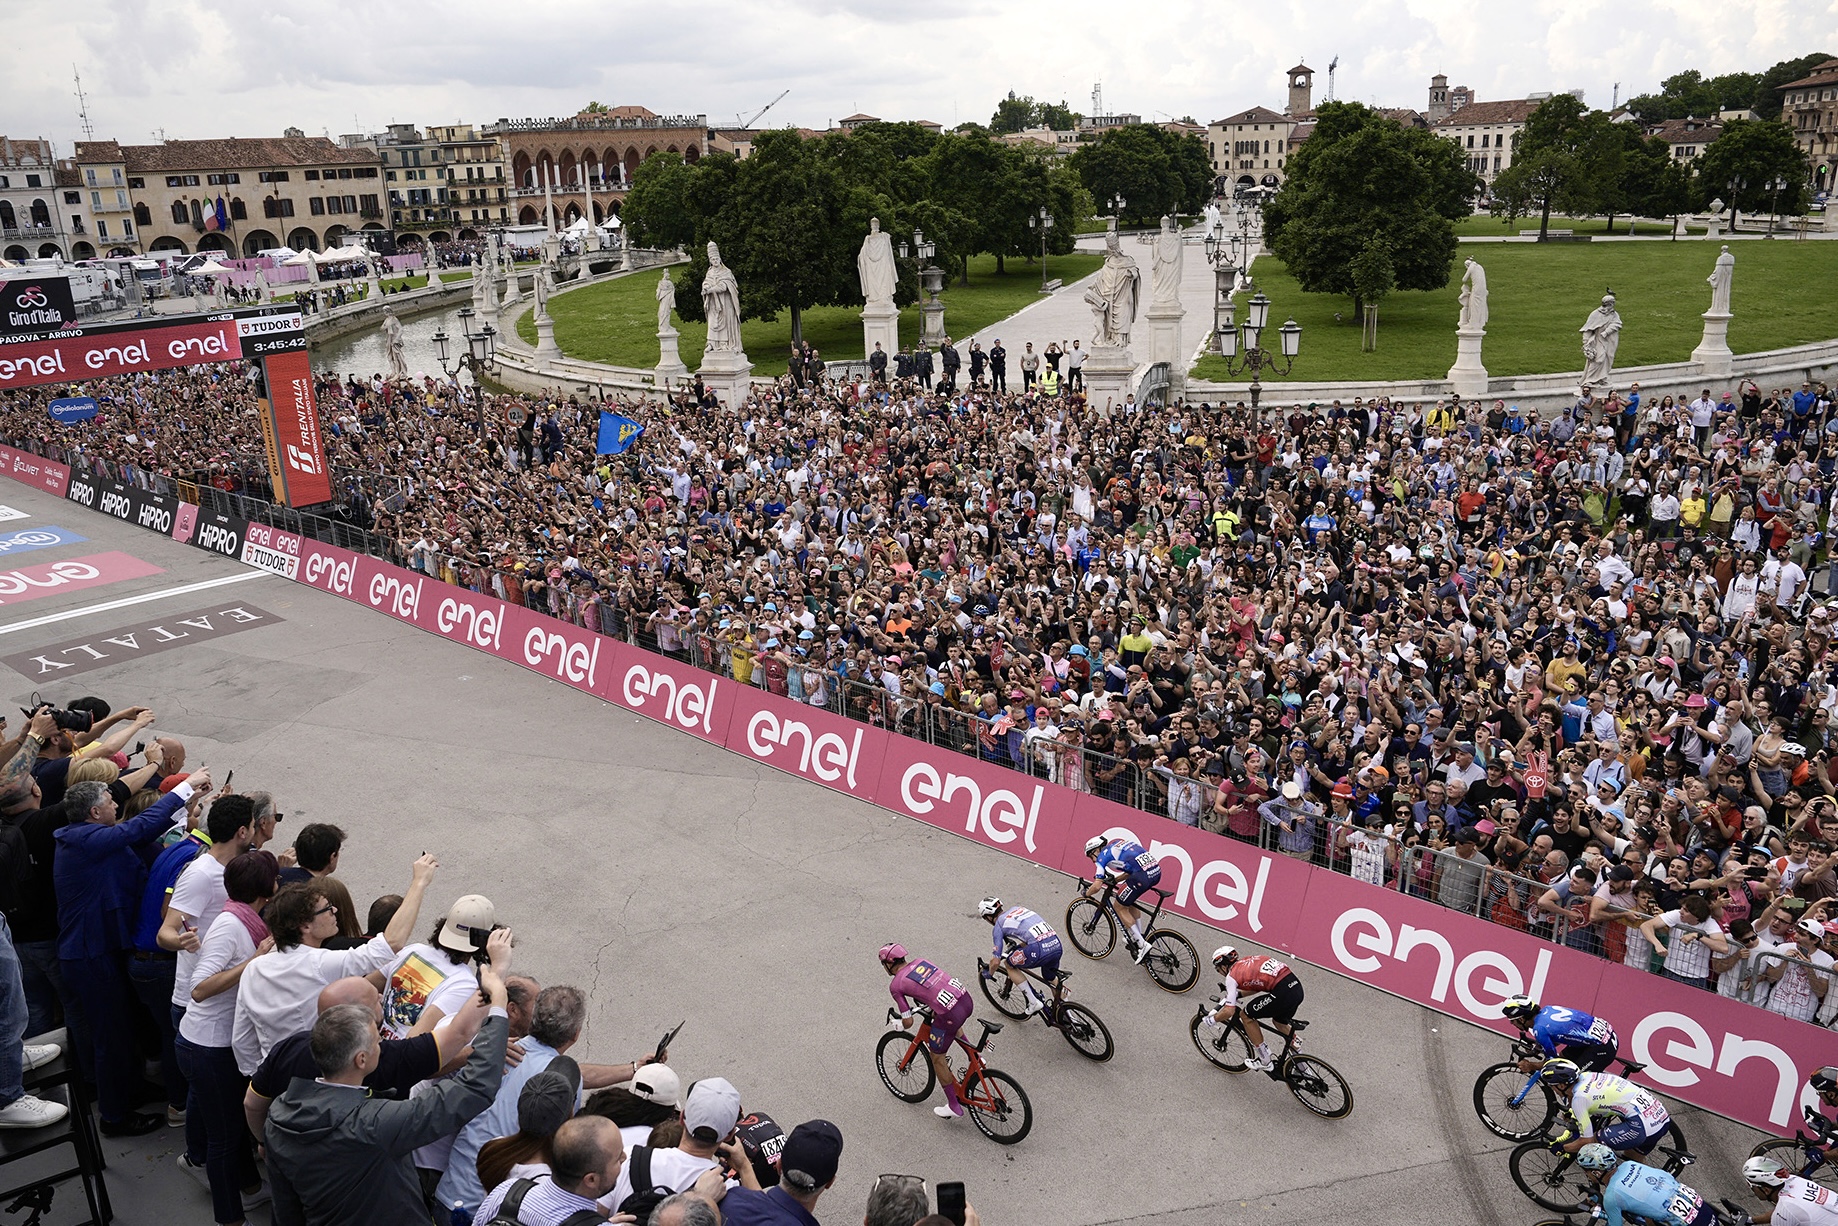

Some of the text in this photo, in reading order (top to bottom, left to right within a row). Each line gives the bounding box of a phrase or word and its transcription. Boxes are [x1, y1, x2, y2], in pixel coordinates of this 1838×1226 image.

[9, 308, 62, 327] Giro d'Italia
[252, 319, 291, 333] TUDOR
[0, 335, 40, 345] PADOVA
[48, 329, 83, 340] ARRIVO
[168, 329, 229, 359] enel
[254, 337, 306, 352] 3:45:42
[0, 348, 66, 380] enel
[85, 339, 150, 369] enel
[292, 378, 311, 447] TRENITALIA
[69, 480, 95, 506] HiPRO
[100, 491, 131, 519] HiPRO
[138, 503, 171, 533] HiPRO
[198, 522, 238, 556] HiPRO
[249, 526, 301, 555] enel enel
[253, 549, 287, 572] TUDOR
[305, 552, 358, 596] enel
[369, 572, 424, 621] enel
[437, 597, 505, 651] enel
[29, 606, 263, 674] EATALY
[524, 627, 601, 688] enel
[623, 664, 718, 735] enel
[747, 709, 864, 790] enel
[900, 762, 1045, 854] enel
[1331, 907, 1553, 1020] enel
[938, 990, 954, 1006] 111
[1252, 996, 1273, 1012] Cofidis
[877, 1055, 905, 1098] BONTRAGER
[1636, 1094, 1651, 1110] 95
[1621, 1164, 1637, 1186] ASTANA
[1803, 1182, 1819, 1202] UAE
[1673, 1199, 1691, 1217] 32
